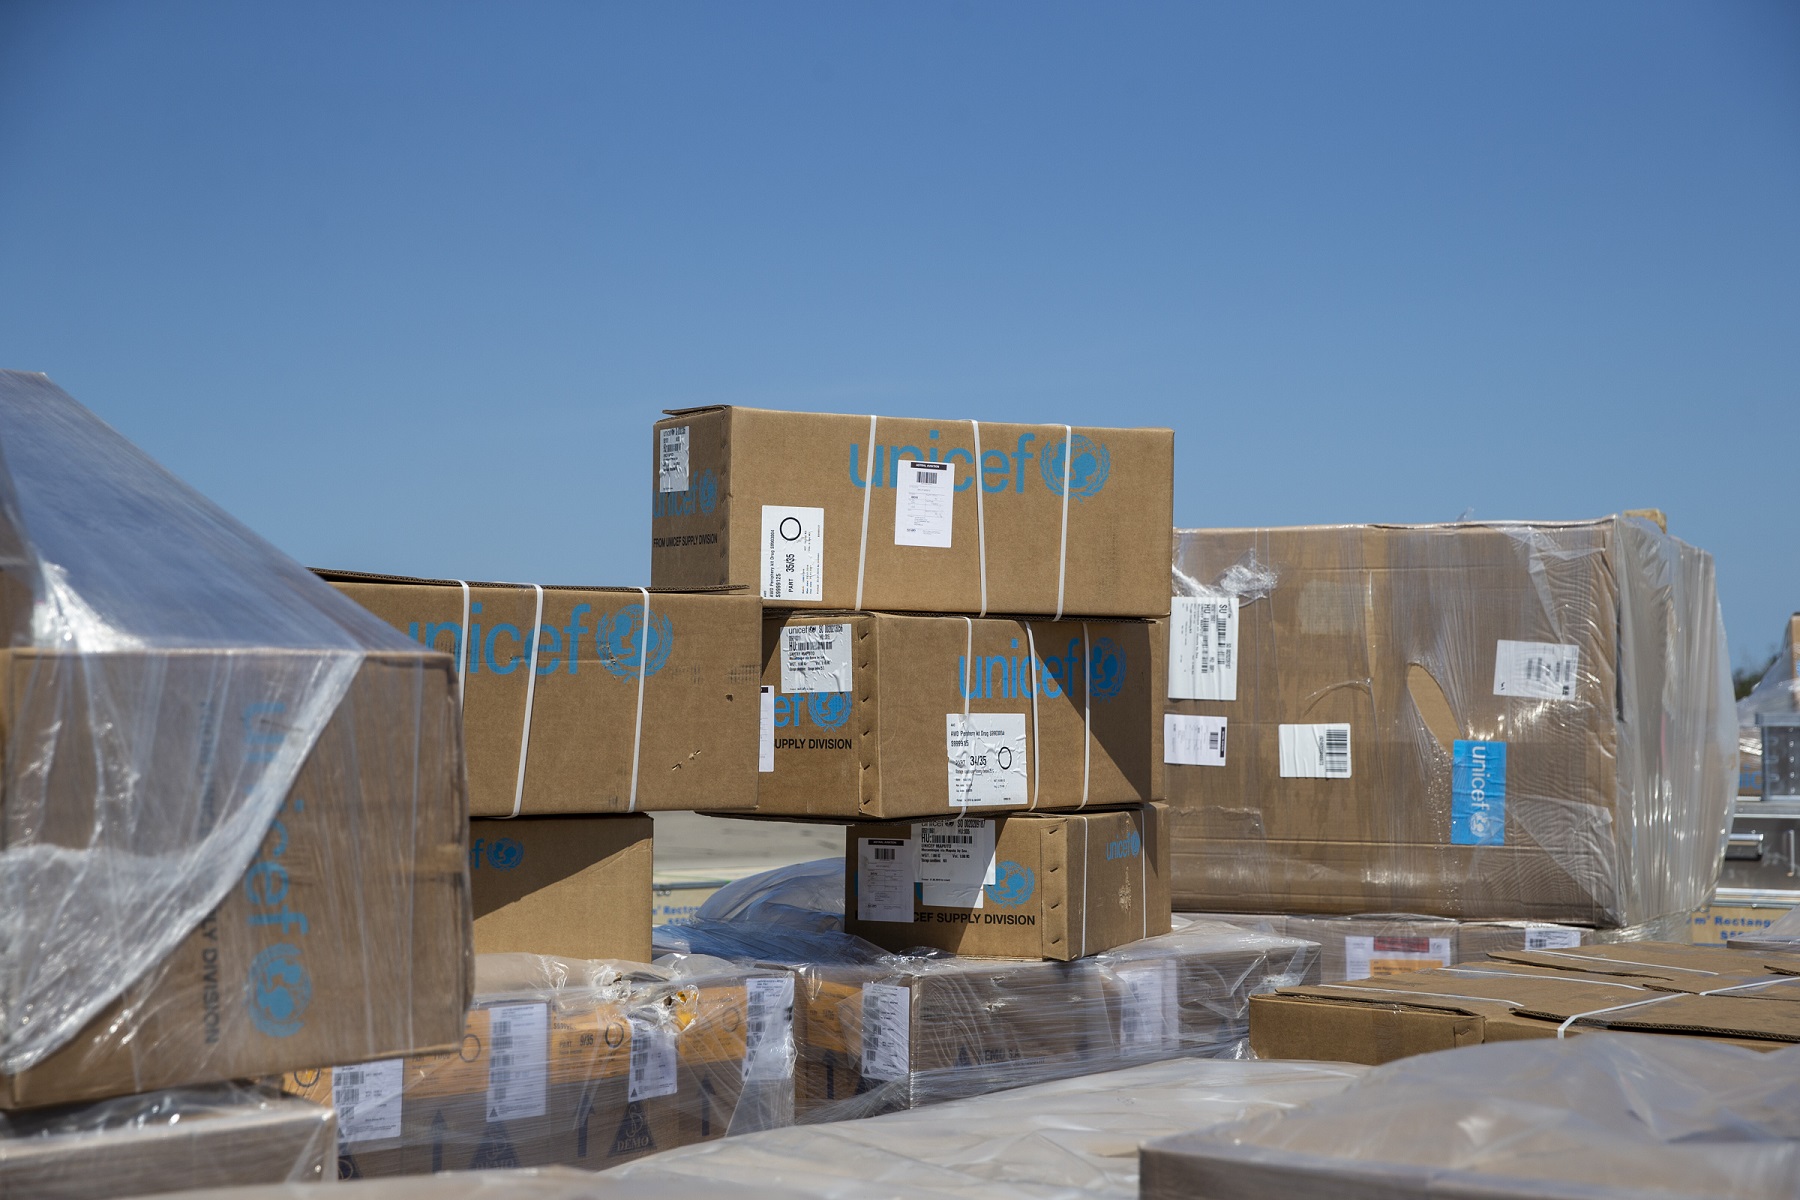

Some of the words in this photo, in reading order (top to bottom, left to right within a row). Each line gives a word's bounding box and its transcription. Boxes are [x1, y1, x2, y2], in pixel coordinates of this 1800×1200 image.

[849, 430, 1036, 494] unicef
[653, 538, 666, 548] FROM
[666, 536, 681, 548] UNICEF
[682, 535, 698, 547] SUPPLY
[699, 533, 718, 545] DIVISION
[785, 553, 795, 573] 35/35
[1219, 604, 1228, 614] SU
[408, 602, 591, 675] nicef
[959, 637, 1080, 700] unicef
[774, 738, 806, 750] UPPLY
[808, 738, 852, 750] DIVISION
[969, 755, 987, 766] 34/35
[1471, 746, 1490, 811] unicef
[244, 700, 309, 936] ucef
[1106, 832, 1130, 861] unicef
[914, 912, 934, 922] CEF
[936, 912, 981, 924] SUPPLY
[984, 914, 1035, 926] DIVISION
[1714, 915, 1771, 928] Rectang
[203, 948, 220, 1044] DIVISION
[617, 1136, 649, 1152] DEMO
